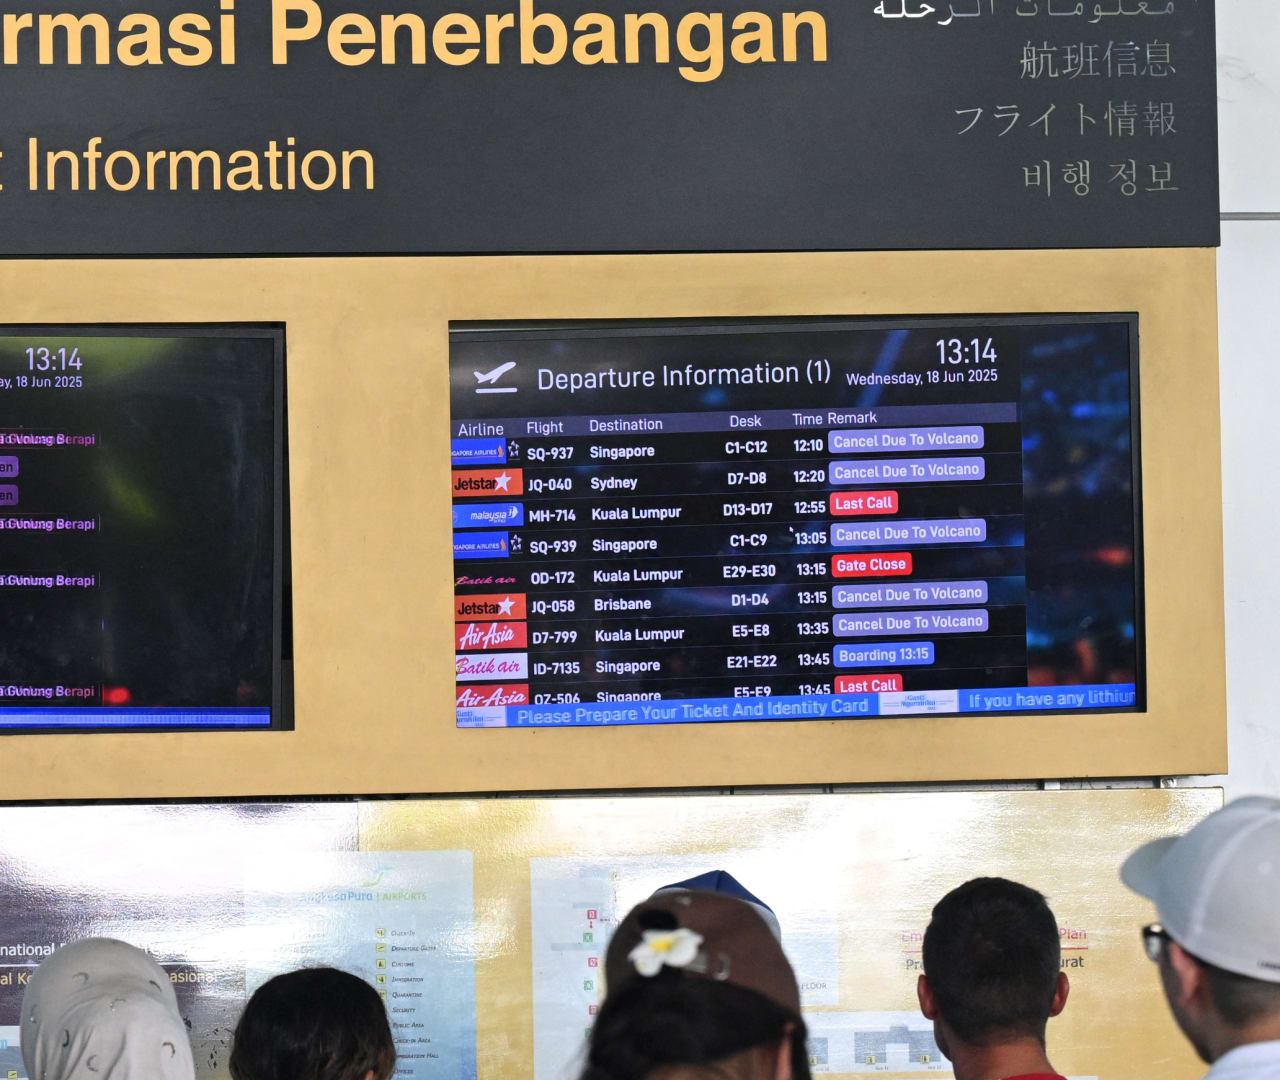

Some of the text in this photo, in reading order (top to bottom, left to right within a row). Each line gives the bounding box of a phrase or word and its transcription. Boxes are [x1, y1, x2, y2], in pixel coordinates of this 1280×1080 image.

[273, 0, 828, 81] Penerbangan
[1020, 40, 1176, 79] 航班信息
[955, 101, 1177, 137] フライト情報
[30, 136, 375, 193] Information
[1021, 159, 1179, 197] 비행 정보
[26, 347, 82, 370] 13:14
[937, 338, 997, 364] 13:14
[16, 376, 27, 387] 18
[32, 376, 51, 387] Jun
[55, 376, 82, 387] 2025
[538, 360, 830, 393] Departure Information (1)
[846, 369, 997, 388] Wednesday, 18 Jun 2025
[459, 411, 877, 436] Airline Flight Destination Desk Time Remark
[528, 433, 978, 461] SQ-937 Singapore C1-C12 12:10 Cancel Due To Volcano
[455, 464, 979, 493] Jetstar JQ-040 Sydney D7-D8 12:20 Cancel Due To Volcano
[529, 497, 892, 522] MH-714 Kuala Lumpur D13-D17 12:55 Last Call
[530, 525, 980, 555] SQ-939 Singapore C1-C9 13:05 Cancel Due To Volcano
[531, 559, 906, 584] OD-172 Kuala Lumpur E29-E30 13:15 Gate Close
[458, 591, 827, 615] Jetstar JQ-058 Brisbane D1-D4 13:15
[498, 659, 520, 672] air
[534, 662, 580, 675] ID-7135
[596, 661, 660, 674] Singapore
[727, 655, 777, 668] E21-E22
[798, 653, 829, 665] 13:45
[840, 649, 896, 662] Boarding
[900, 648, 928, 659] 13:15
[518, 698, 868, 725] Please Prepare Your Ticket And Identity Card
[970, 694, 981, 707] If
[984, 696, 1010, 710] you
[1017, 692, 1053, 706] have
[1057, 694, 1084, 708] any
